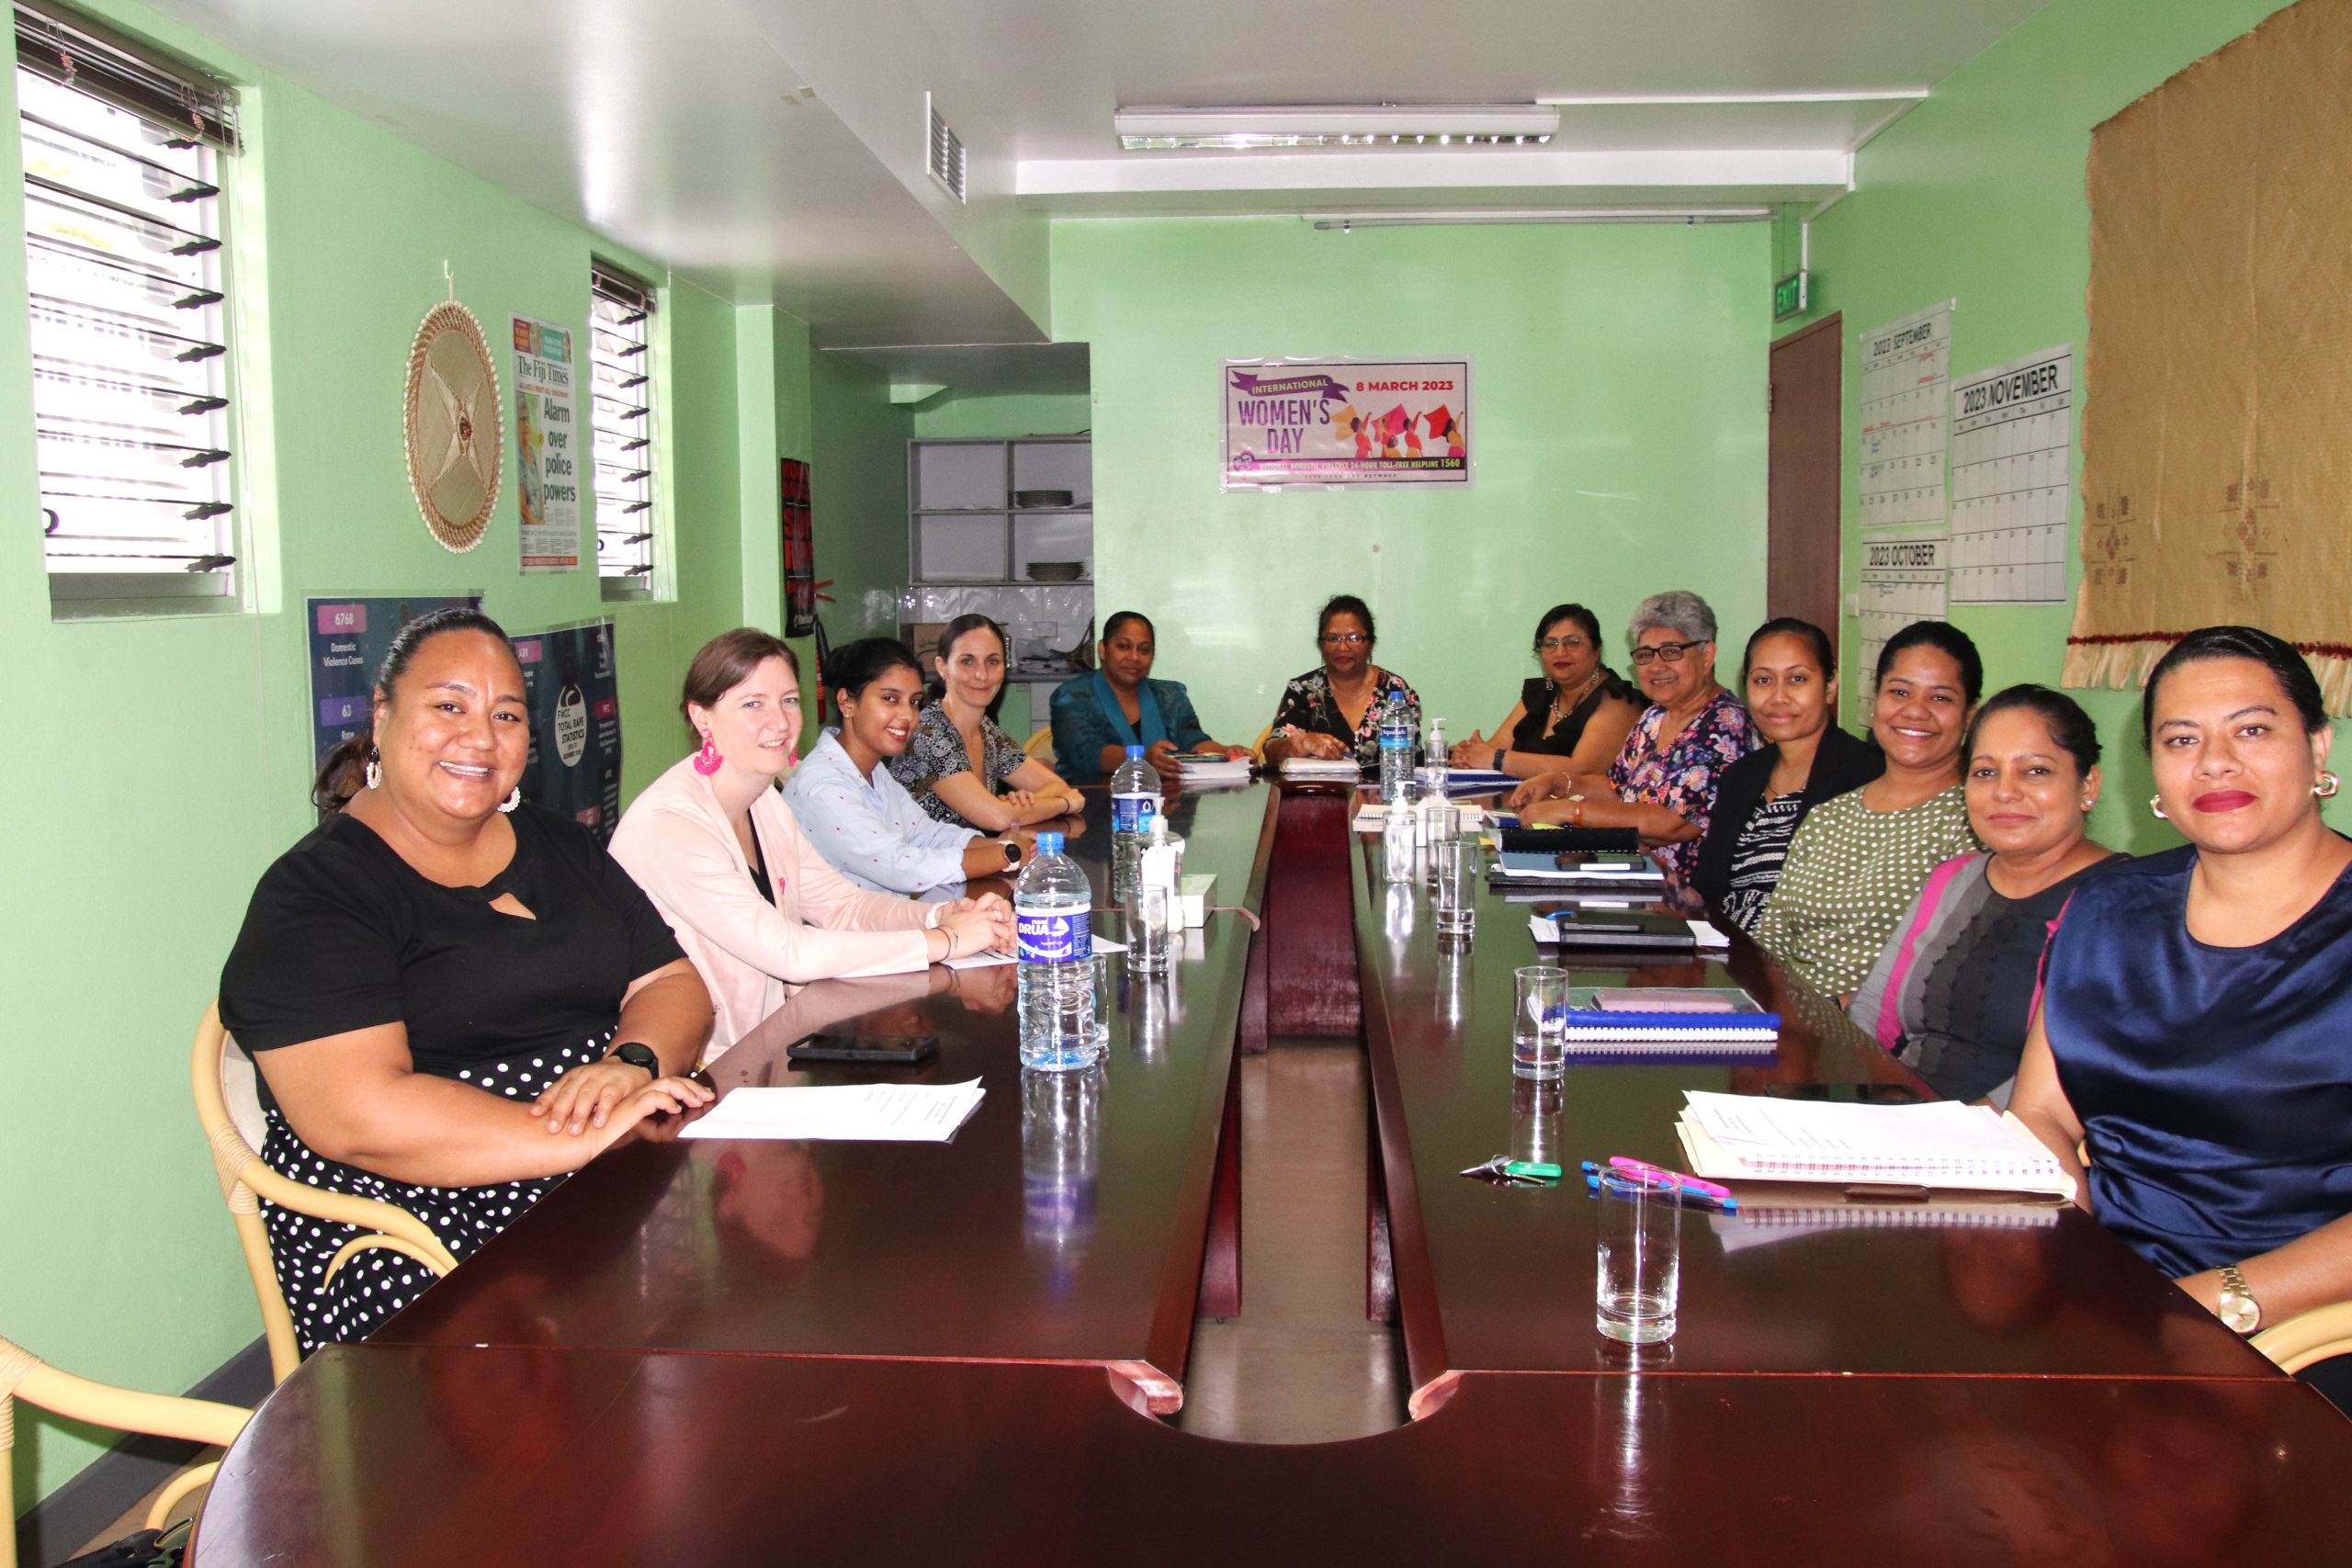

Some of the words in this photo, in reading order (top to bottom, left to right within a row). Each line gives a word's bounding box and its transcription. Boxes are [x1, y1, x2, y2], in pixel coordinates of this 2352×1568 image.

[1873, 337, 1891, 356] 2023
[1893, 322, 1931, 350] SEPTEMBER
[517, 355, 532, 377] The
[533, 359, 546, 383] Fiji
[547, 363, 570, 385] Times
[1251, 378, 1329, 395] INTERNATIONAL
[1356, 381, 1364, 391] 8
[1368, 381, 1419, 391] MARCH
[1422, 380, 1453, 391] 2023
[1963, 386, 1986, 414] 2023
[1988, 365, 2058, 407] NOVEMBER
[544, 398, 571, 423] Alarm
[1238, 399, 1330, 426] WOMEN'S
[548, 431, 568, 449] over
[1267, 427, 1304, 454] DAY
[546, 452, 572, 478] police
[1322, 461, 1349, 469] VIOLENCE
[1350, 460, 1378, 468] 24-HOUR
[1379, 460, 1409, 468] TOLL-FREE
[1410, 460, 1439, 468] HELPLINE
[1441, 458, 1461, 468] 1560
[544, 484, 576, 505] powers
[1870, 547, 1890, 566] 2023
[1892, 544, 1935, 566] OCTOBER
[334, 613, 354, 626] 6768
[331, 641, 356, 652] Domestic
[323, 657, 348, 667] Violence
[348, 656, 364, 666] Cases
[342, 704, 352, 717] 63
[558, 708, 571, 720] FWCC
[558, 719, 572, 733] TOTAL
[573, 716, 583, 728] RAPE
[562, 728, 584, 744] STATISTICS
[1018, 922, 1050, 935] DRUA
